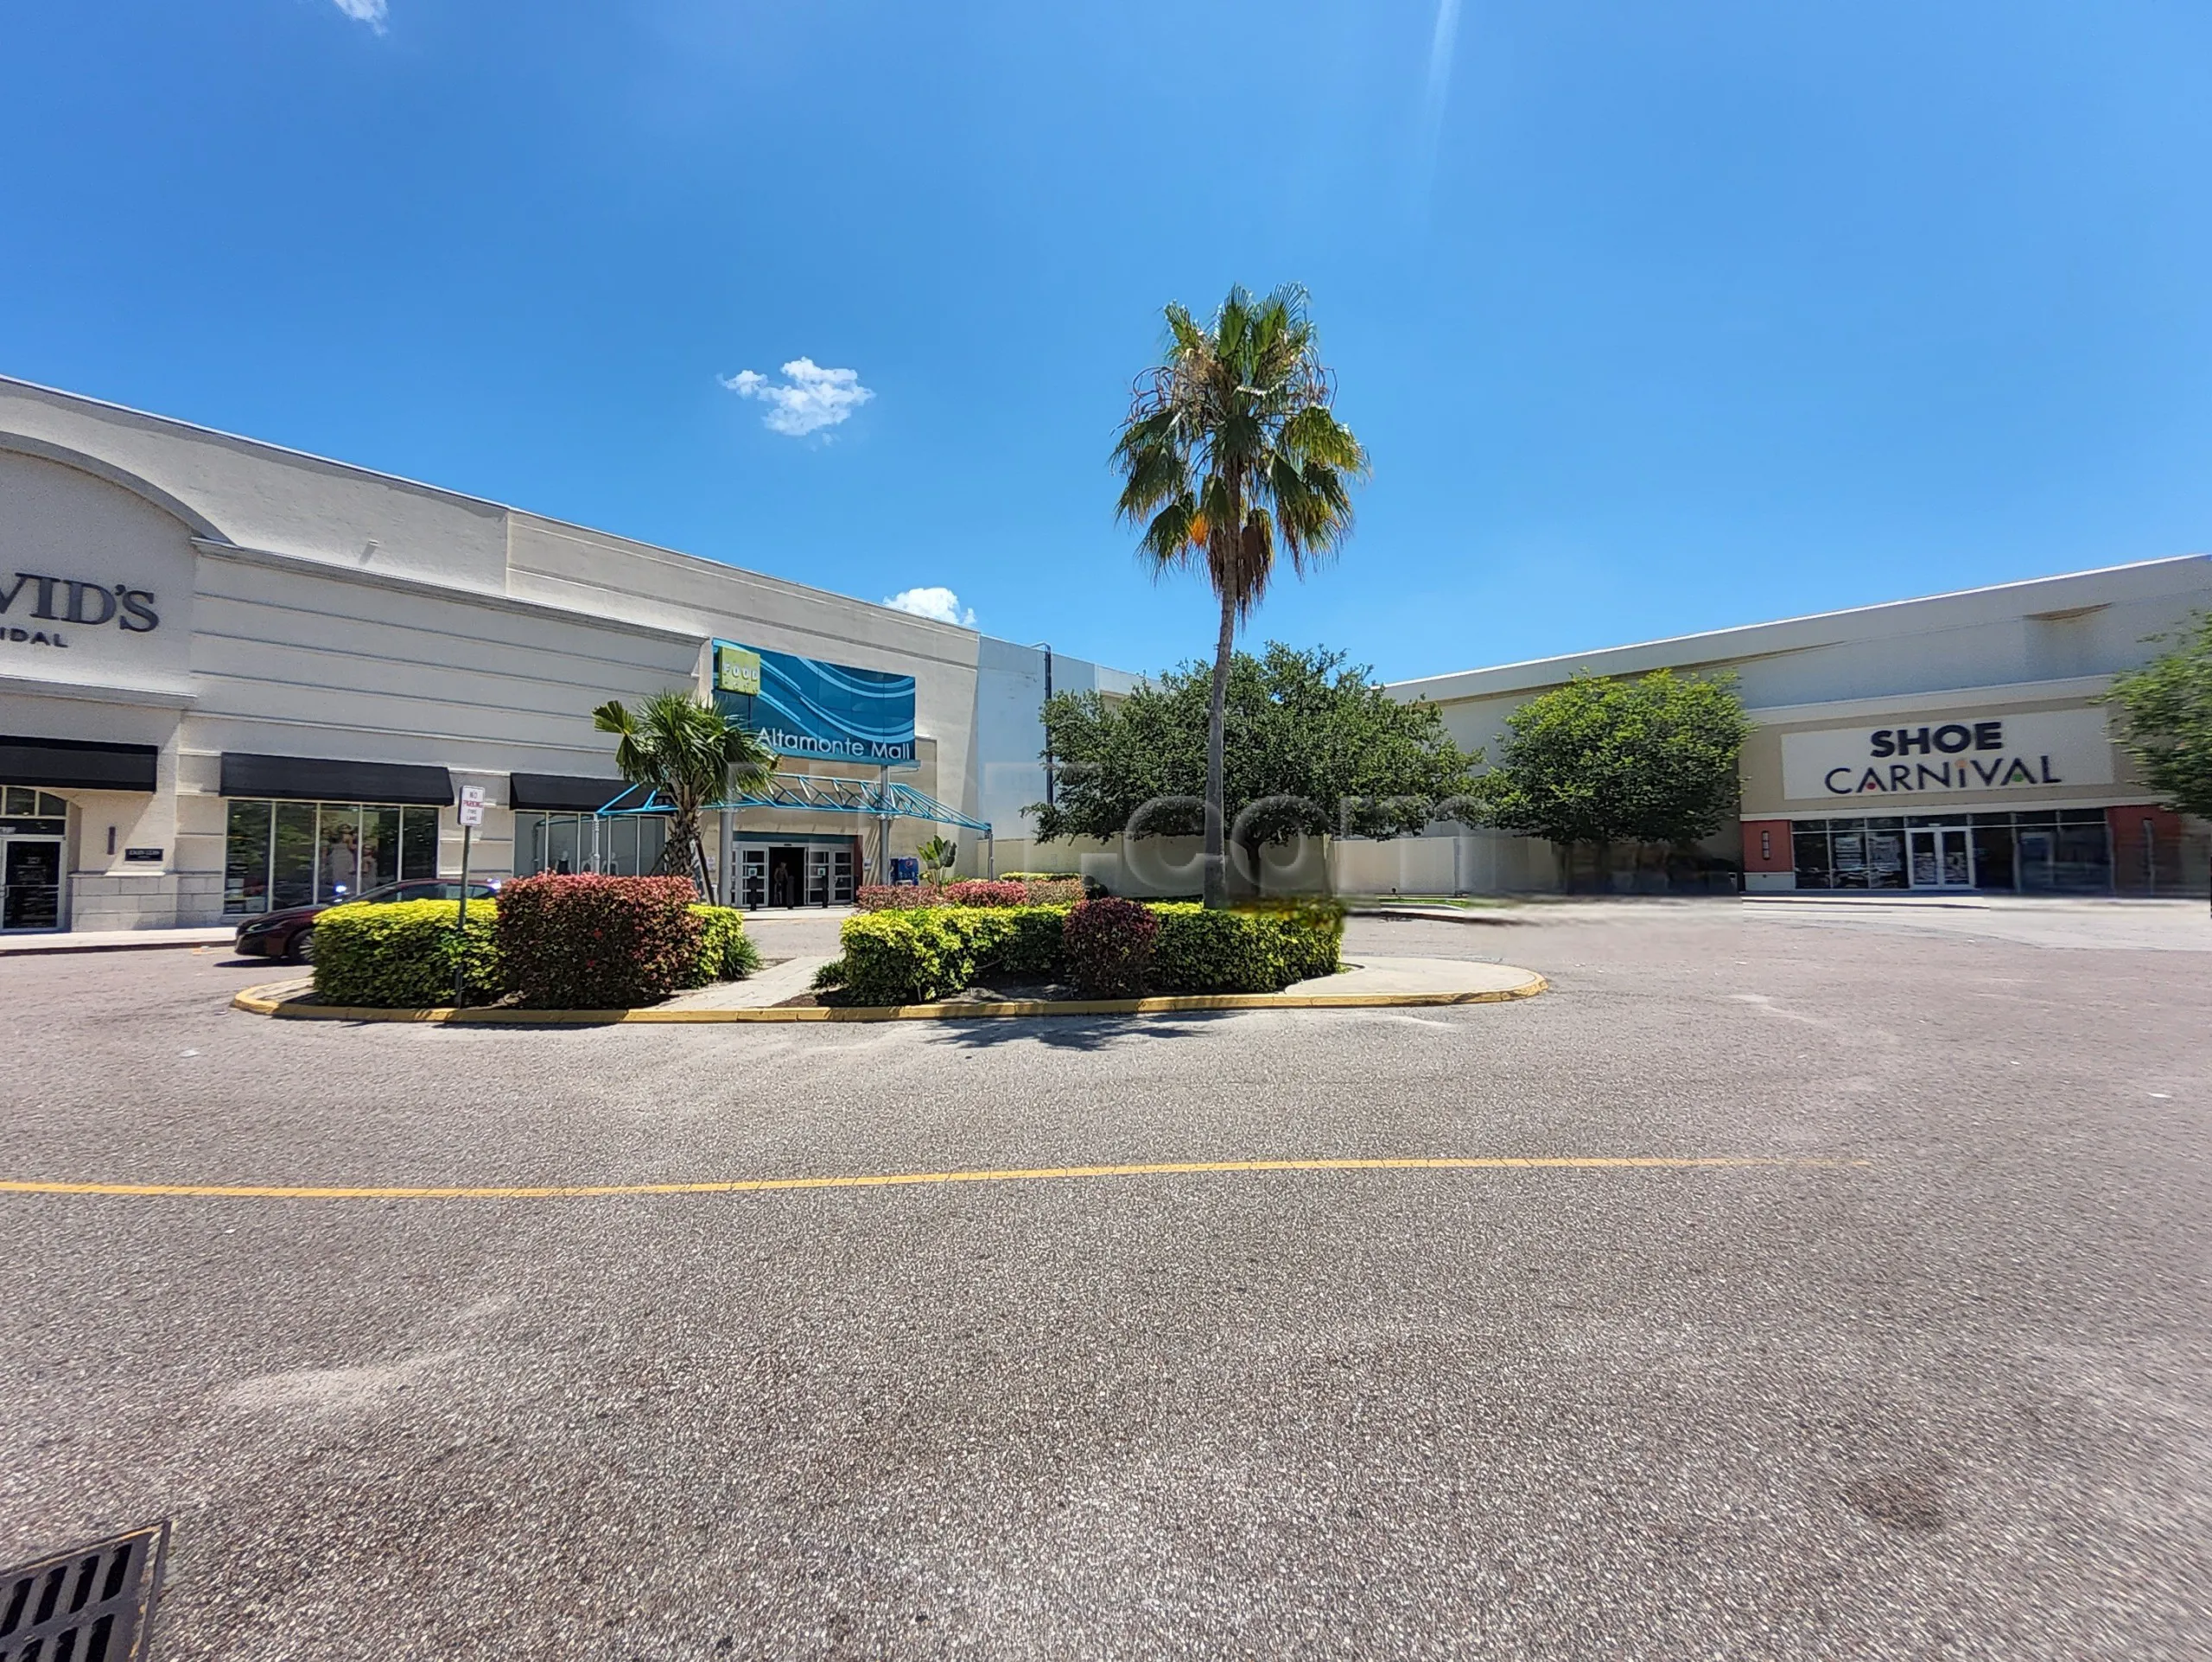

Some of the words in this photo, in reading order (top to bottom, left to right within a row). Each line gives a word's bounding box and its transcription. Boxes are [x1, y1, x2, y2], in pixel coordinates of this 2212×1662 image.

[723, 663, 759, 681] FOOD
[754, 726, 864, 756] Altamonte
[871, 741, 910, 760] Mall
[1870, 722, 2004, 757] SHOE
